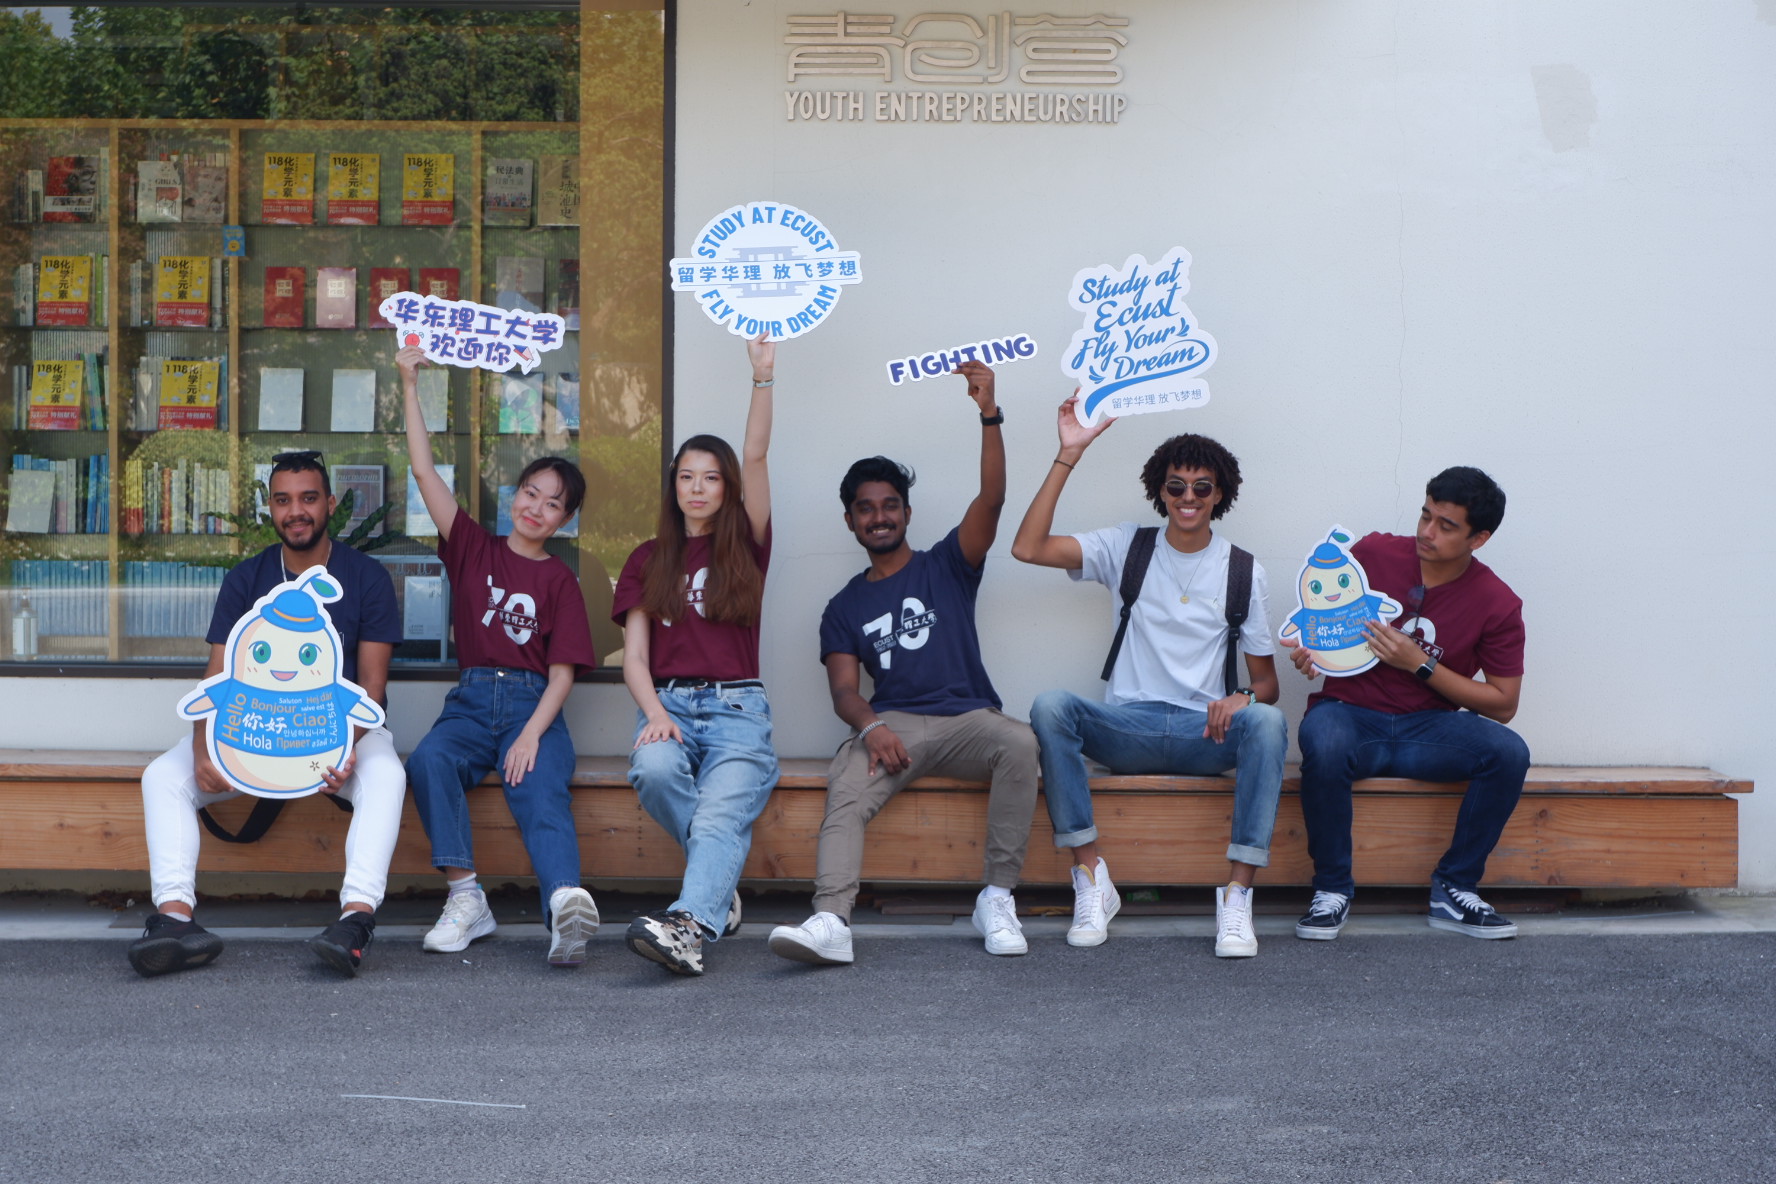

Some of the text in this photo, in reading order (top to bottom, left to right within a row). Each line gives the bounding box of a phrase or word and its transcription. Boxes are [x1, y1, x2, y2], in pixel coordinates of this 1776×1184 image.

[784, 11, 1129, 84] 青创营
[784, 91, 1127, 123] YOUTH ENTREPRENEURSHIP
[268, 156, 283, 166] 118
[333, 157, 348, 167] 118
[407, 157, 422, 167] 118
[697, 206, 835, 259] STUDY AT ECUST
[44, 259, 60, 269] 118
[162, 259, 178, 269] 118
[678, 260, 857, 284] 留学华理 放飞梦想
[1079, 257, 1184, 306] Study at
[701, 284, 838, 337] FLY YOUR DREAM
[1093, 282, 1182, 333] Ecust
[395, 297, 559, 345] 华东理工大学
[429, 333, 512, 366] 欢迎你
[889, 336, 1035, 383] FIGHTING
[1071, 325, 1176, 372] Fly Your
[37, 363, 52, 373] 118
[173, 364, 188, 374] 118
[1113, 344, 1200, 381] Dream
[1111, 388, 1202, 409] 留学华理 放飞梦想
[1305, 616, 1319, 647] Hello
[1317, 623, 1344, 637] 你好
[1346, 615, 1367, 628] Ciao
[862, 597, 930, 670] 70
[1320, 637, 1340, 648] Hola
[251, 697, 297, 715] Bonjour
[222, 693, 247, 742] Hello
[242, 712, 288, 734] 你好
[293, 713, 327, 728] Ciao
[326, 701, 338, 745] こんにちは
[243, 732, 272, 750] Hola
[276, 737, 311, 751] Привет
[283, 728, 326, 738] 안녕하십니까
